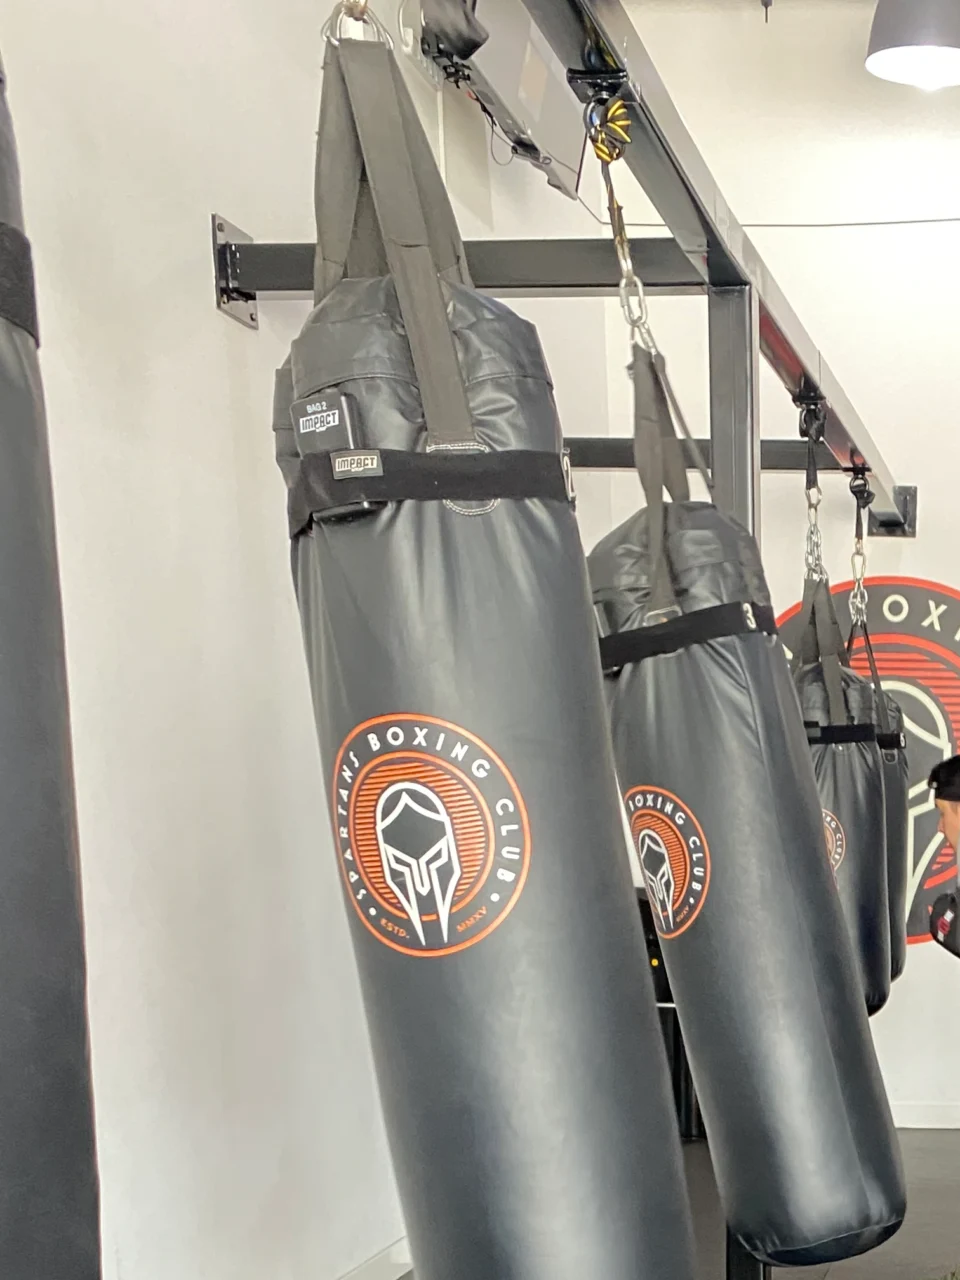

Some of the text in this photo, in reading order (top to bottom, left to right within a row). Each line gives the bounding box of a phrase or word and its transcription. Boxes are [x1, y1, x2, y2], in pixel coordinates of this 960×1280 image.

[306, 401, 327, 414] BAG 2
[301, 411, 337, 431] IMPACT
[337, 457, 376, 470] IMPACT
[743, 602, 757, 629] 3
[338, 726, 521, 900] SPARTANS BOXING CLUB
[688, 836, 704, 891] CLUB
[456, 906, 488, 932] MMXV
